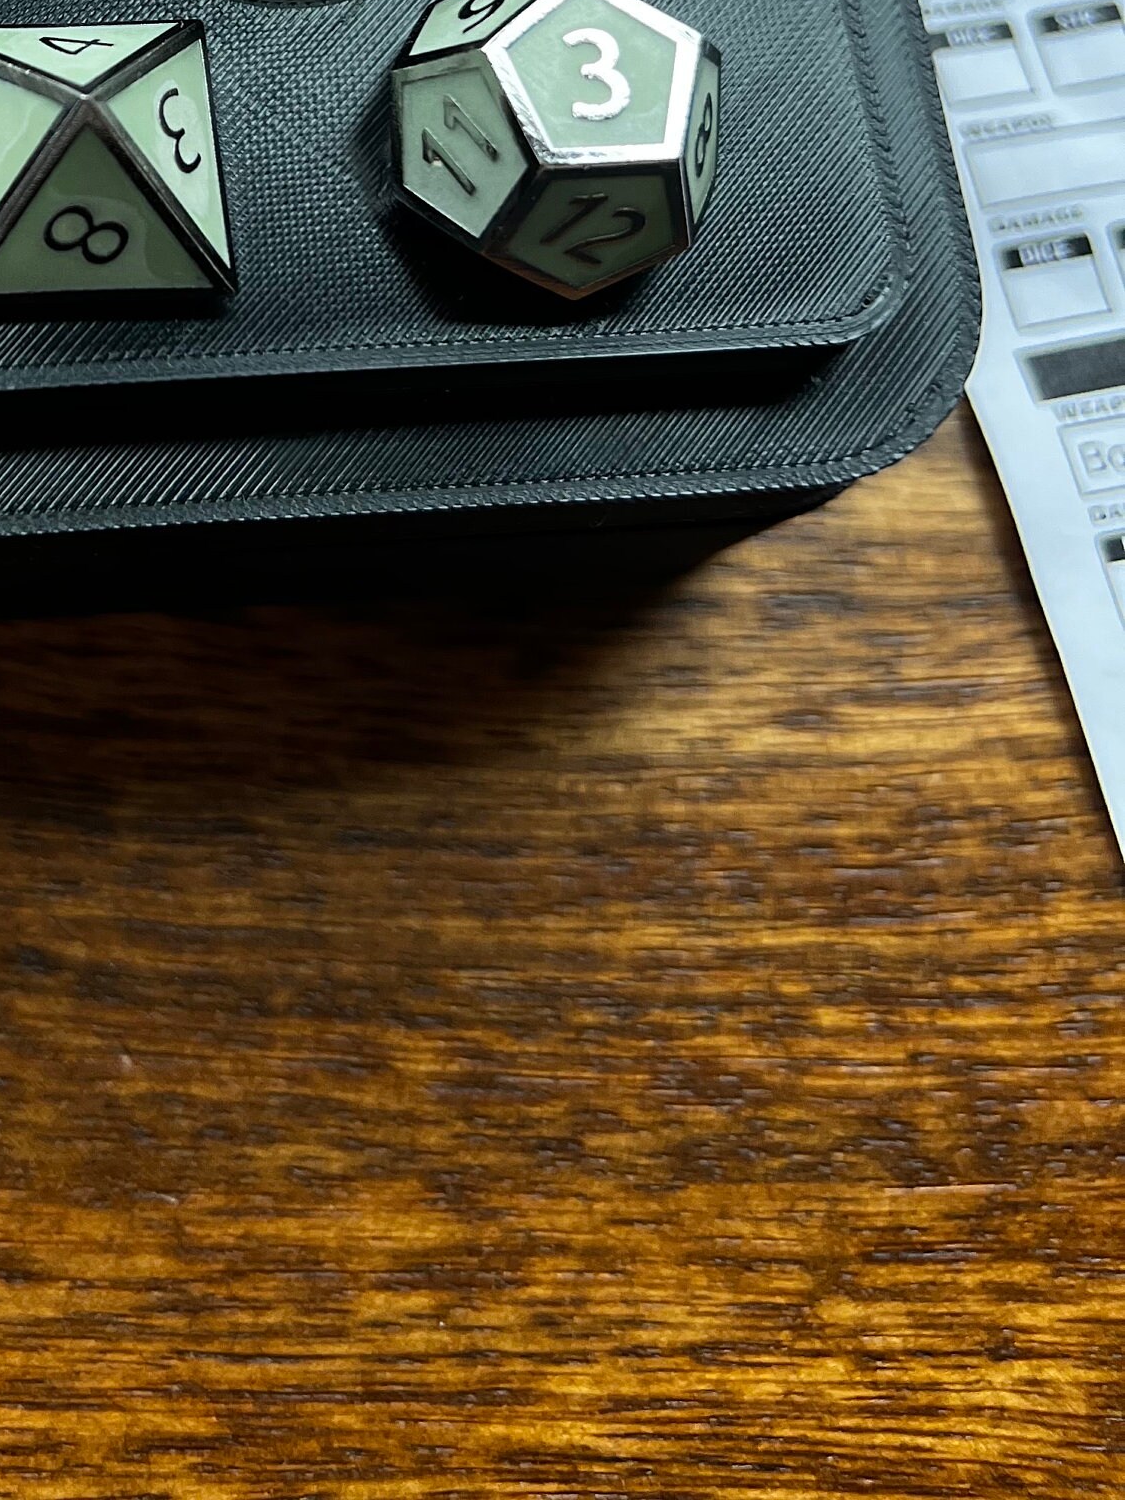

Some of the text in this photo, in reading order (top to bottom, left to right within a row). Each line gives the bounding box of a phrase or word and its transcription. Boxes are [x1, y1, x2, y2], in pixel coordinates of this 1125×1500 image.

[38, 36, 115, 56] 4
[562, 27, 631, 122] 3
[158, 87, 202, 174] 3
[421, 93, 499, 196] 11
[694, 91, 714, 179] 8
[43, 204, 130, 265] 8
[539, 192, 647, 266] 12
